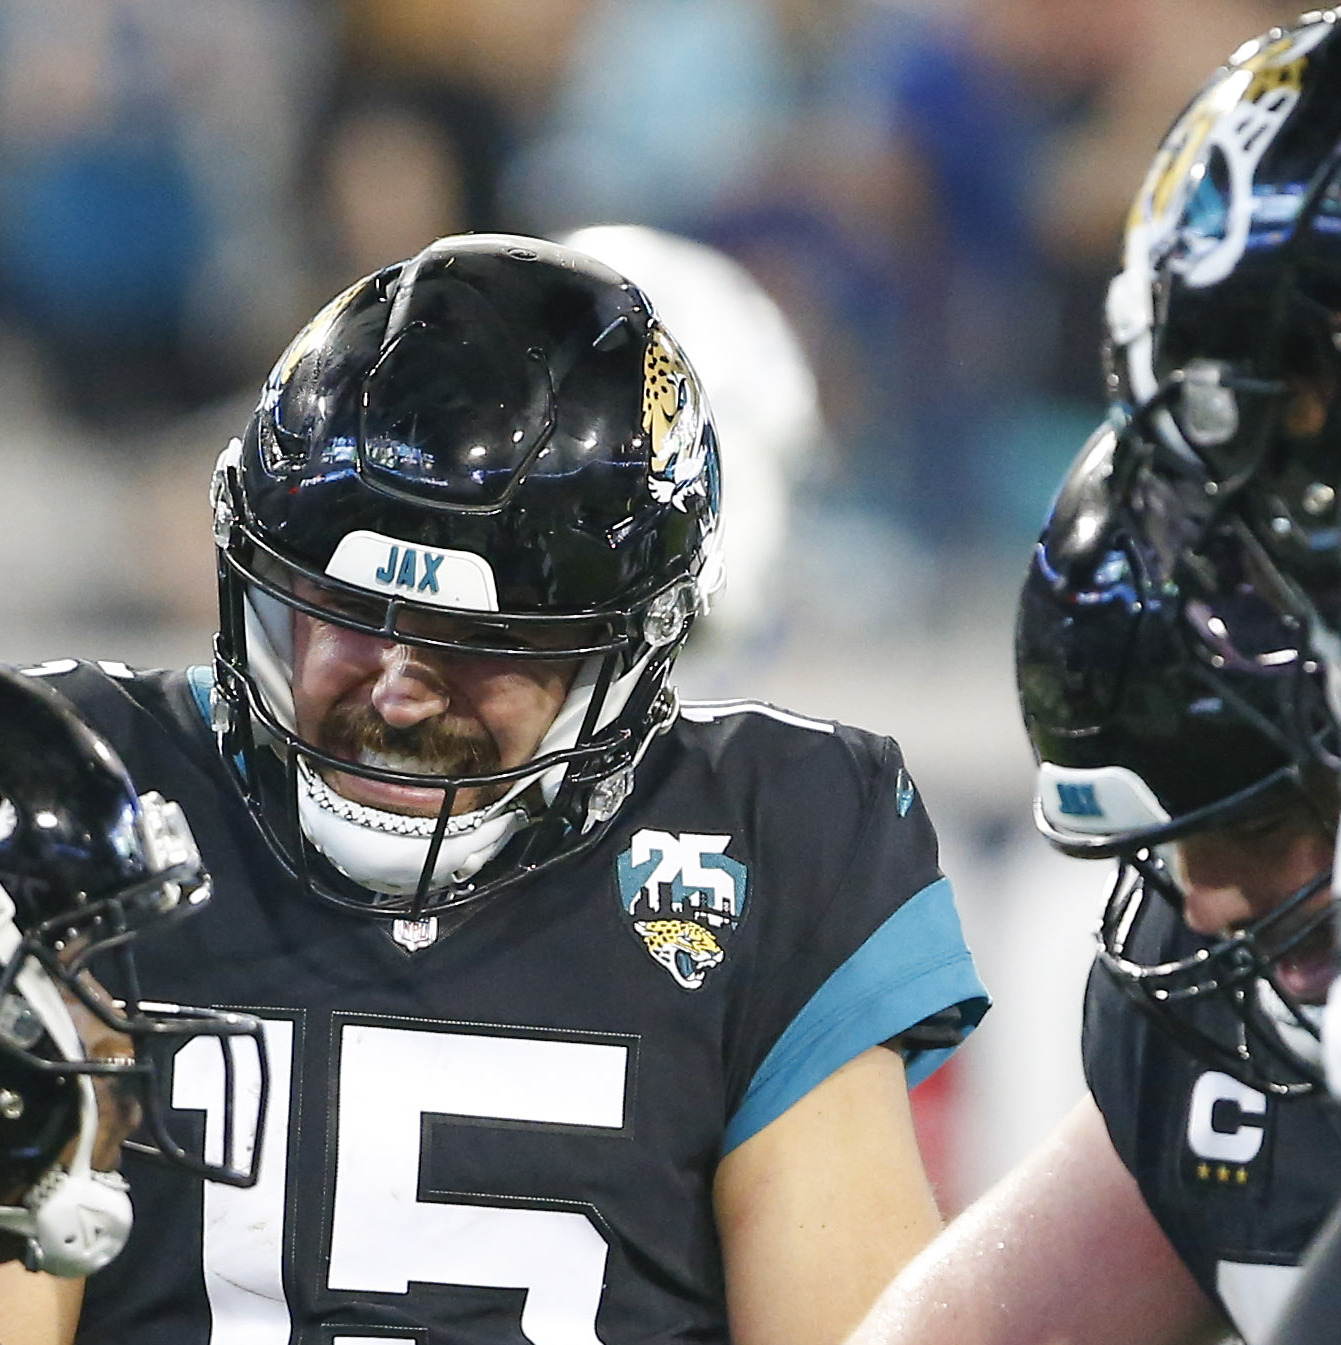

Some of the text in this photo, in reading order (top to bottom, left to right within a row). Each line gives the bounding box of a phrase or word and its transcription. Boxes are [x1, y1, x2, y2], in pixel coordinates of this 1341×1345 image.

[376, 545, 444, 593] JAX
[630, 828, 736, 917] 25
[1187, 1070, 1266, 1163] C
